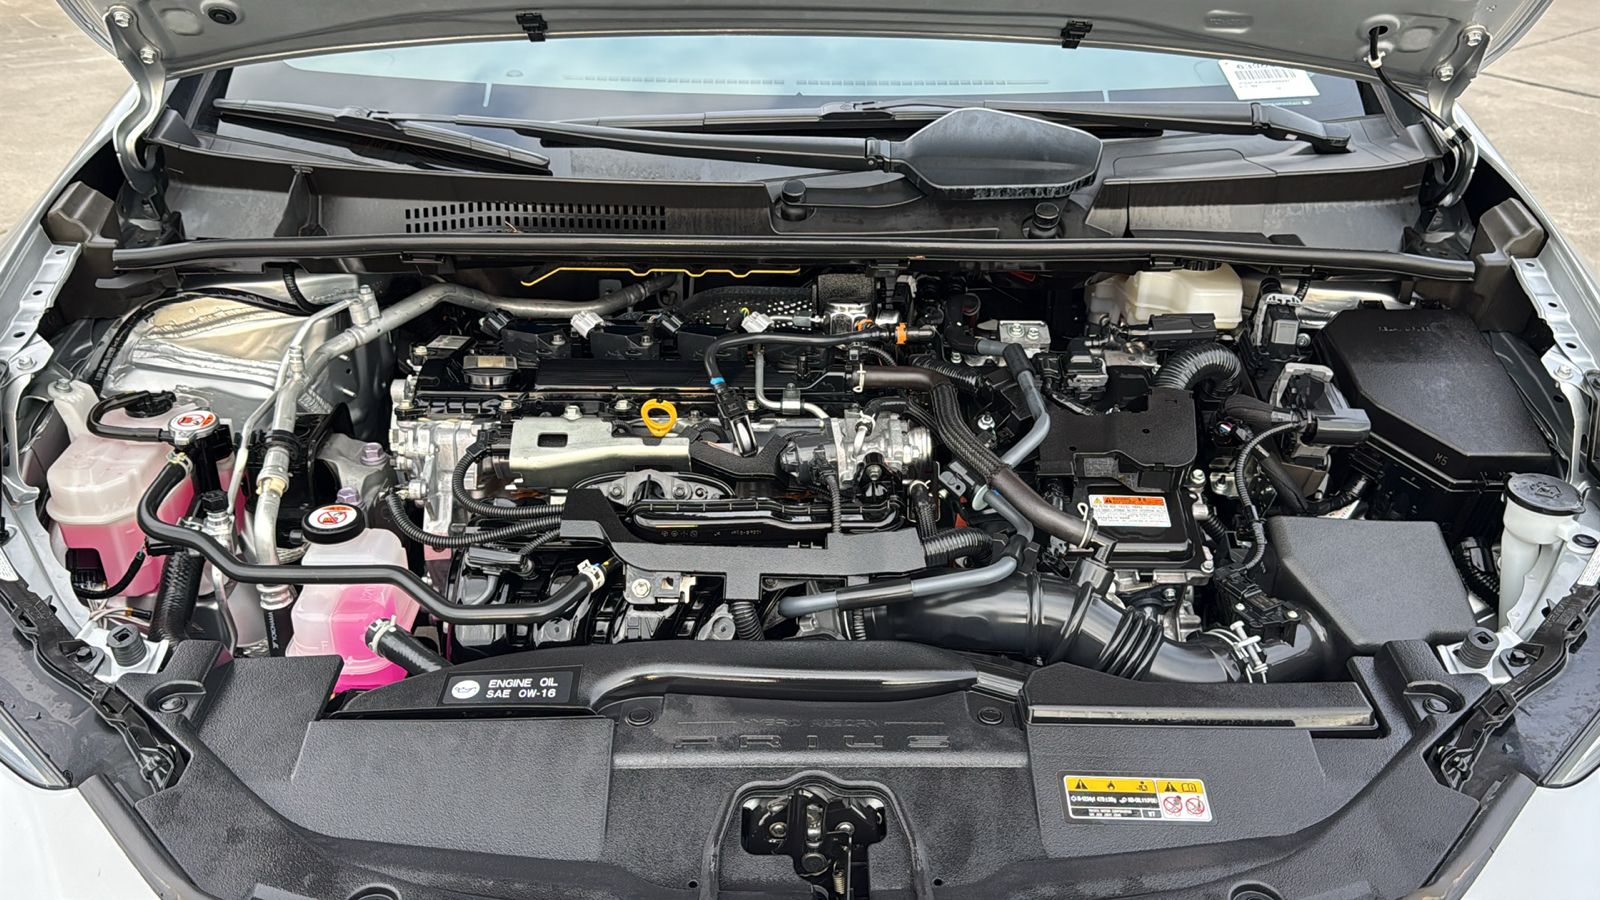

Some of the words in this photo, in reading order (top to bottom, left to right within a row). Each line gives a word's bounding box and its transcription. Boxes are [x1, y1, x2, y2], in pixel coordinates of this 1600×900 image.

[488, 678, 533, 688] ENGINE
[539, 677, 558, 687] OIL
[485, 689, 512, 698] SAE
[518, 688, 557, 698] 0W-16
[674, 735, 950, 749] PRIUS
